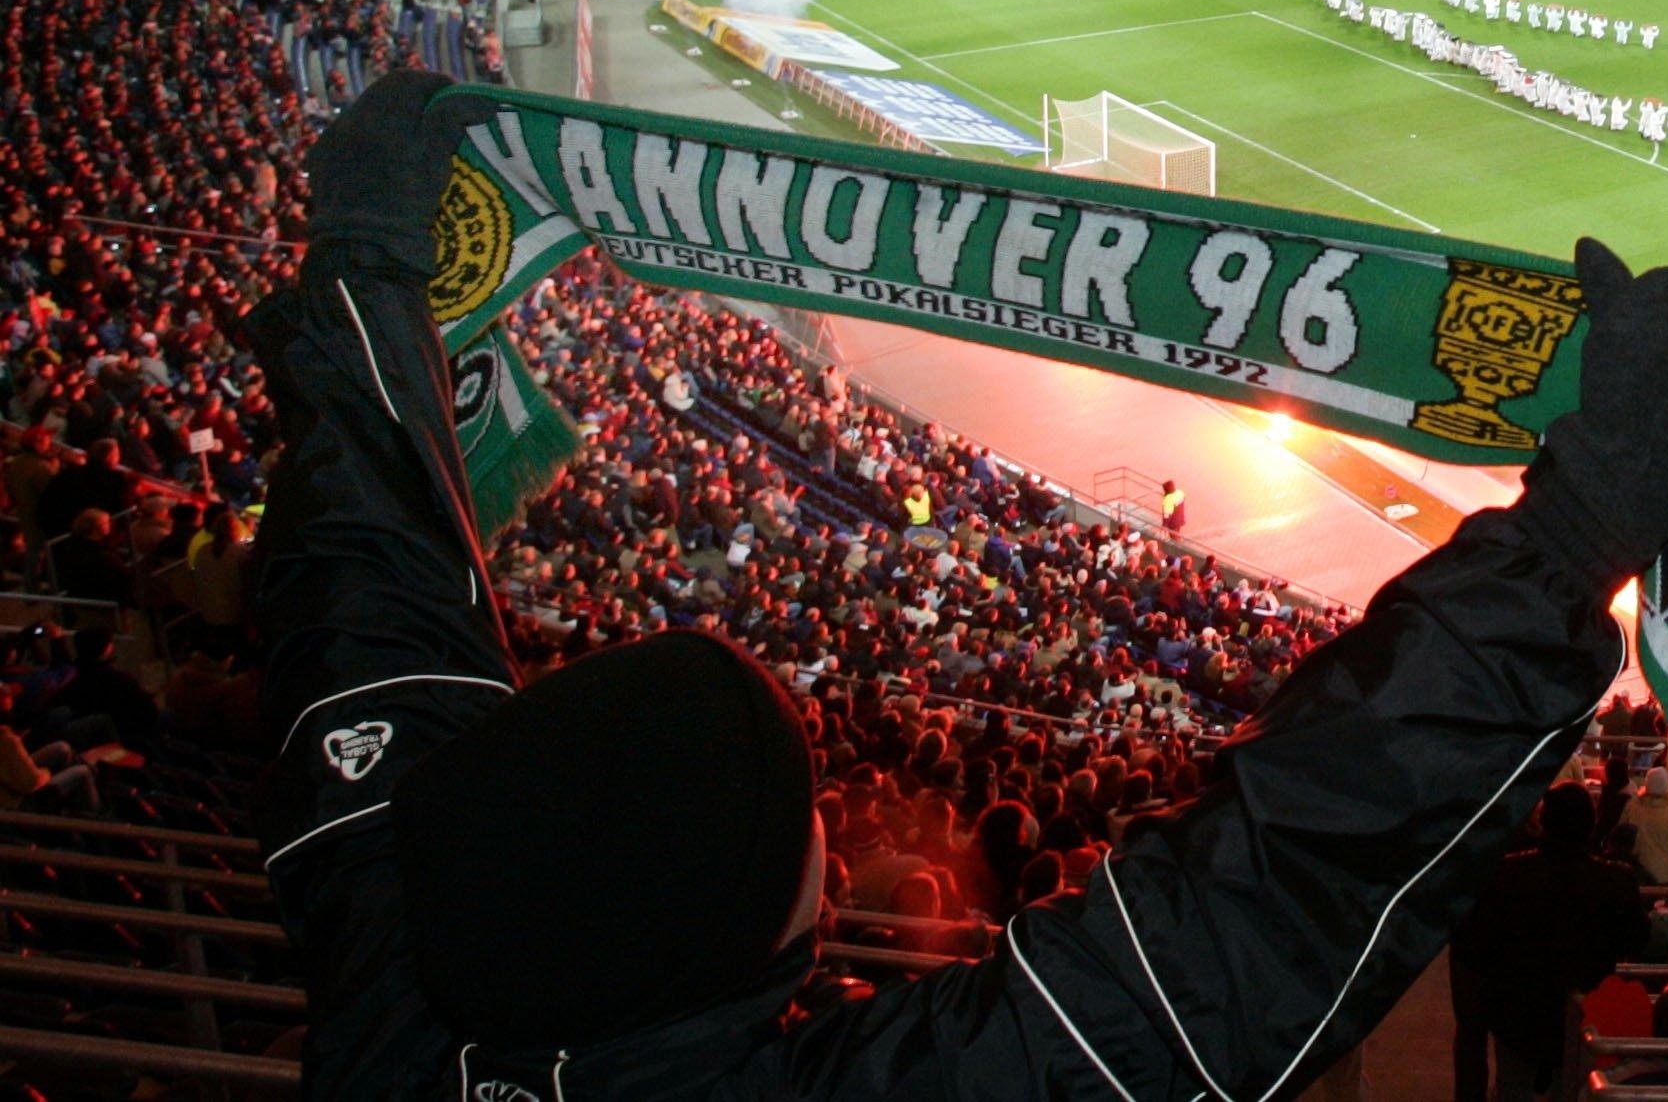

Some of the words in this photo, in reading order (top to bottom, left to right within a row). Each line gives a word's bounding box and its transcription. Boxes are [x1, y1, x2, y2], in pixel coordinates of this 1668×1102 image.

[466, 111, 1149, 328] HANNOVER
[1190, 231, 1360, 373] 96
[600, 236, 808, 289] EUTSCHER
[832, 272, 1140, 356] POKALSIEGER
[1164, 342, 1269, 387] 1992
